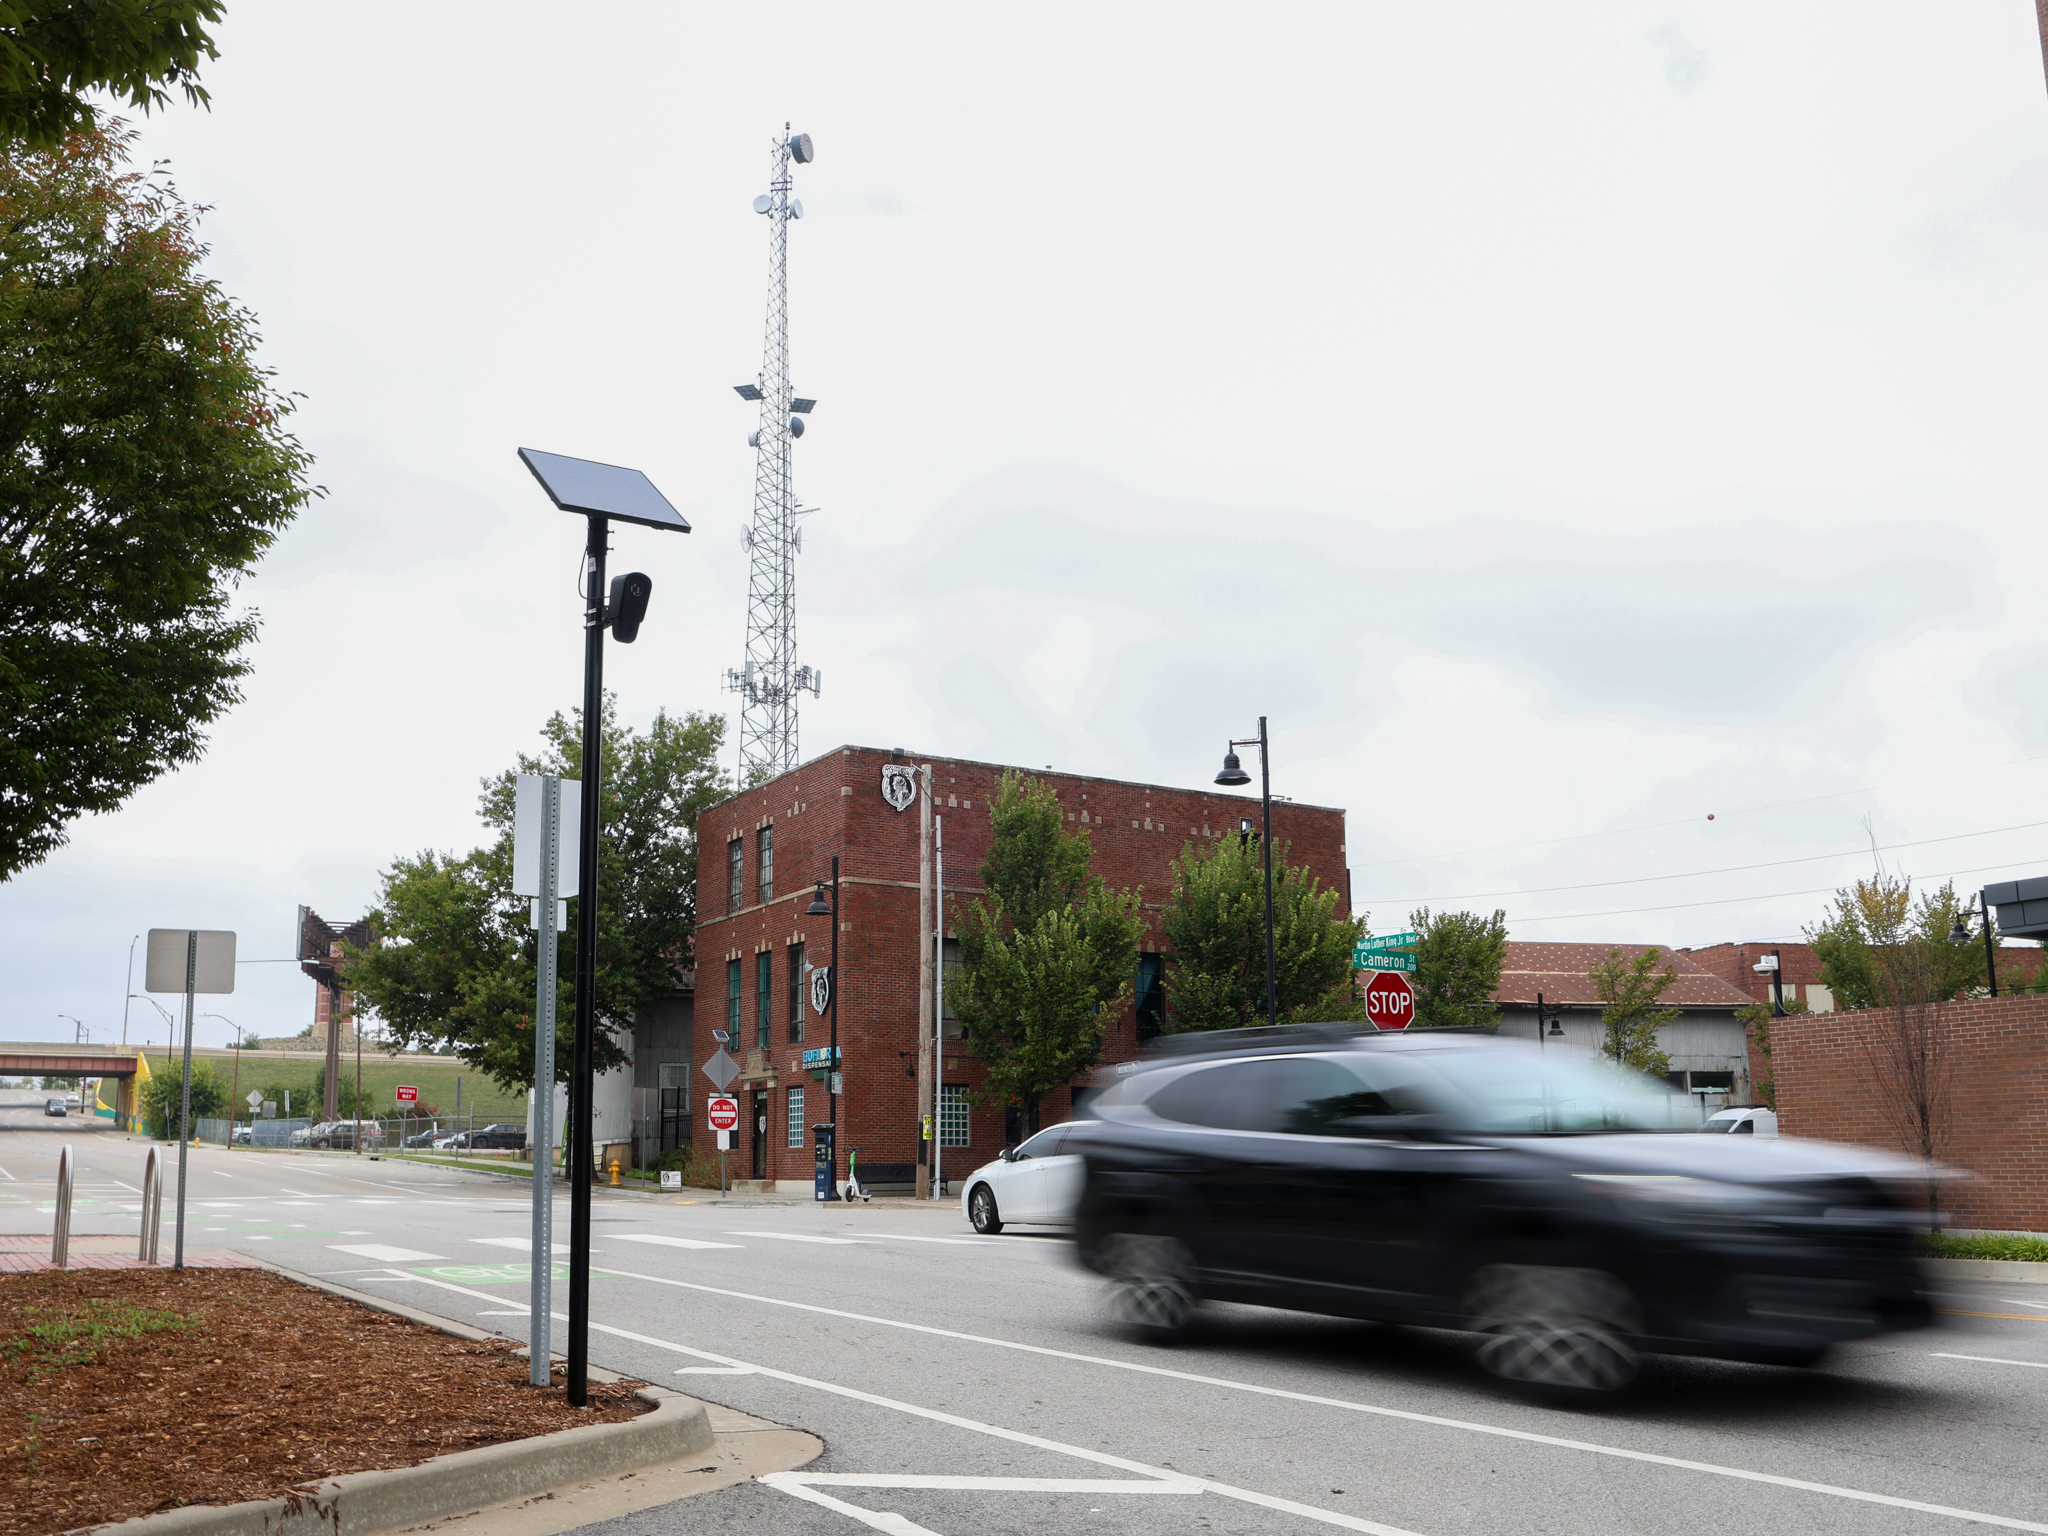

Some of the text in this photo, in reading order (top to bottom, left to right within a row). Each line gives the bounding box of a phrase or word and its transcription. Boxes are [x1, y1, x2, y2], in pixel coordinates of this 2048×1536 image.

[1357, 934, 1416, 949] Martin Luther King Jr Blvd
[1353, 952, 1415, 969] E Cameron St
[1407, 963, 1416, 971] 200
[1369, 991, 1410, 1014] STOP
[803, 1046, 842, 1062] EUFLORA
[803, 1060, 832, 1069] DISPENSA
